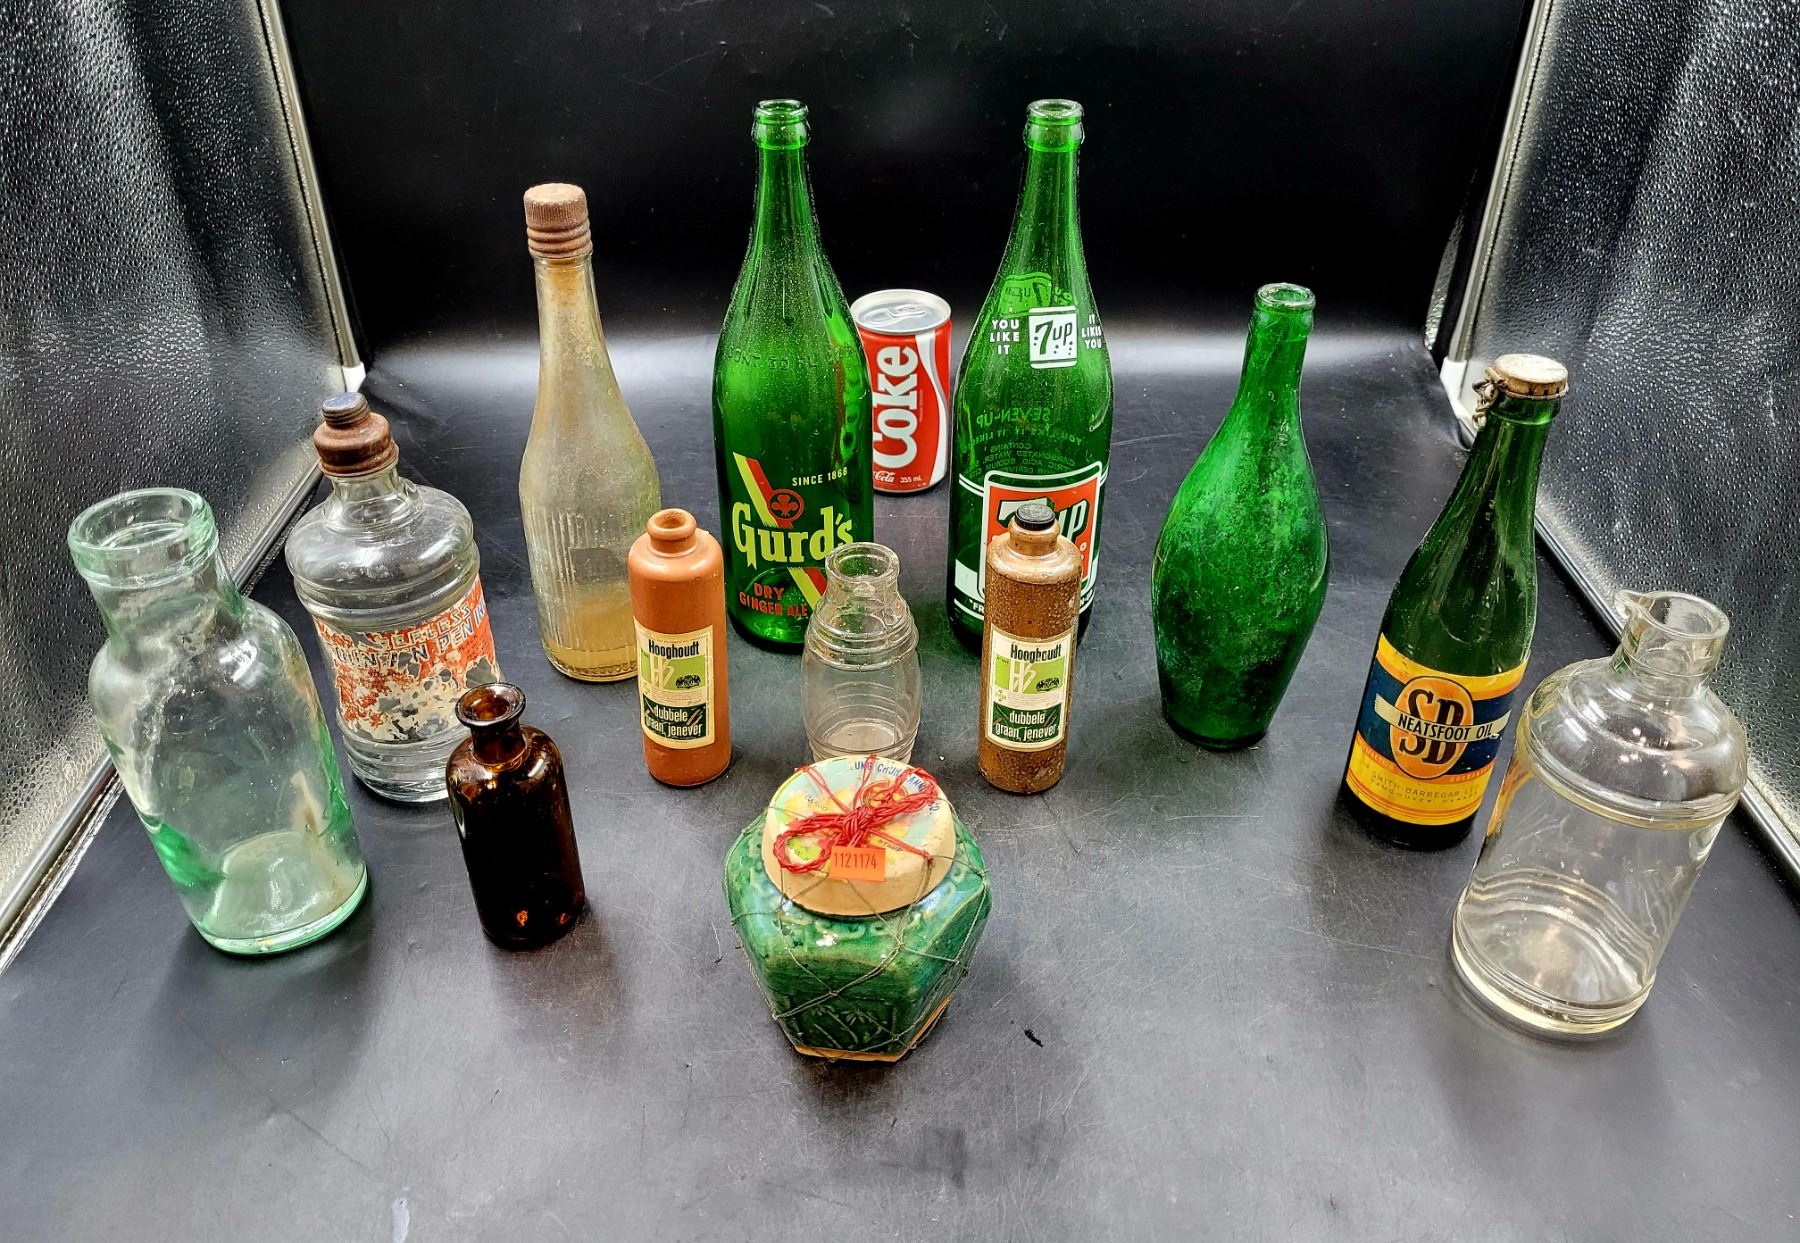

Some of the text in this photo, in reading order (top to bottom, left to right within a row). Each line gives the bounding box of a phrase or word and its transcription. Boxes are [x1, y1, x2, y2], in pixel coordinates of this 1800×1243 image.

[991, 319, 1020, 330] YOU
[989, 331, 1020, 343] LIKE
[1084, 338, 1102, 350] YOU
[997, 344, 1010, 355] IT
[872, 345, 919, 470] Coke
[792, 466, 848, 487] SINCE 1868
[731, 501, 854, 570] Gurd's
[753, 582, 785, 600] DRY
[739, 590, 808, 617] GINGER ALE
[437, 615, 474, 654] PEN
[648, 639, 700, 660] Hooghoudt
[1010, 643, 1062, 664] Hooghoudt
[654, 704, 688, 722] dubbele
[1009, 711, 1046, 725] dubbele
[667, 723, 703, 738] jenever
[995, 723, 1056, 741] graan jenever
[1398, 712, 1493, 741] NEATSFOOT OIL
[1405, 786, 1460, 799] BARREGAR
[833, 852, 877, 870] 1121174
